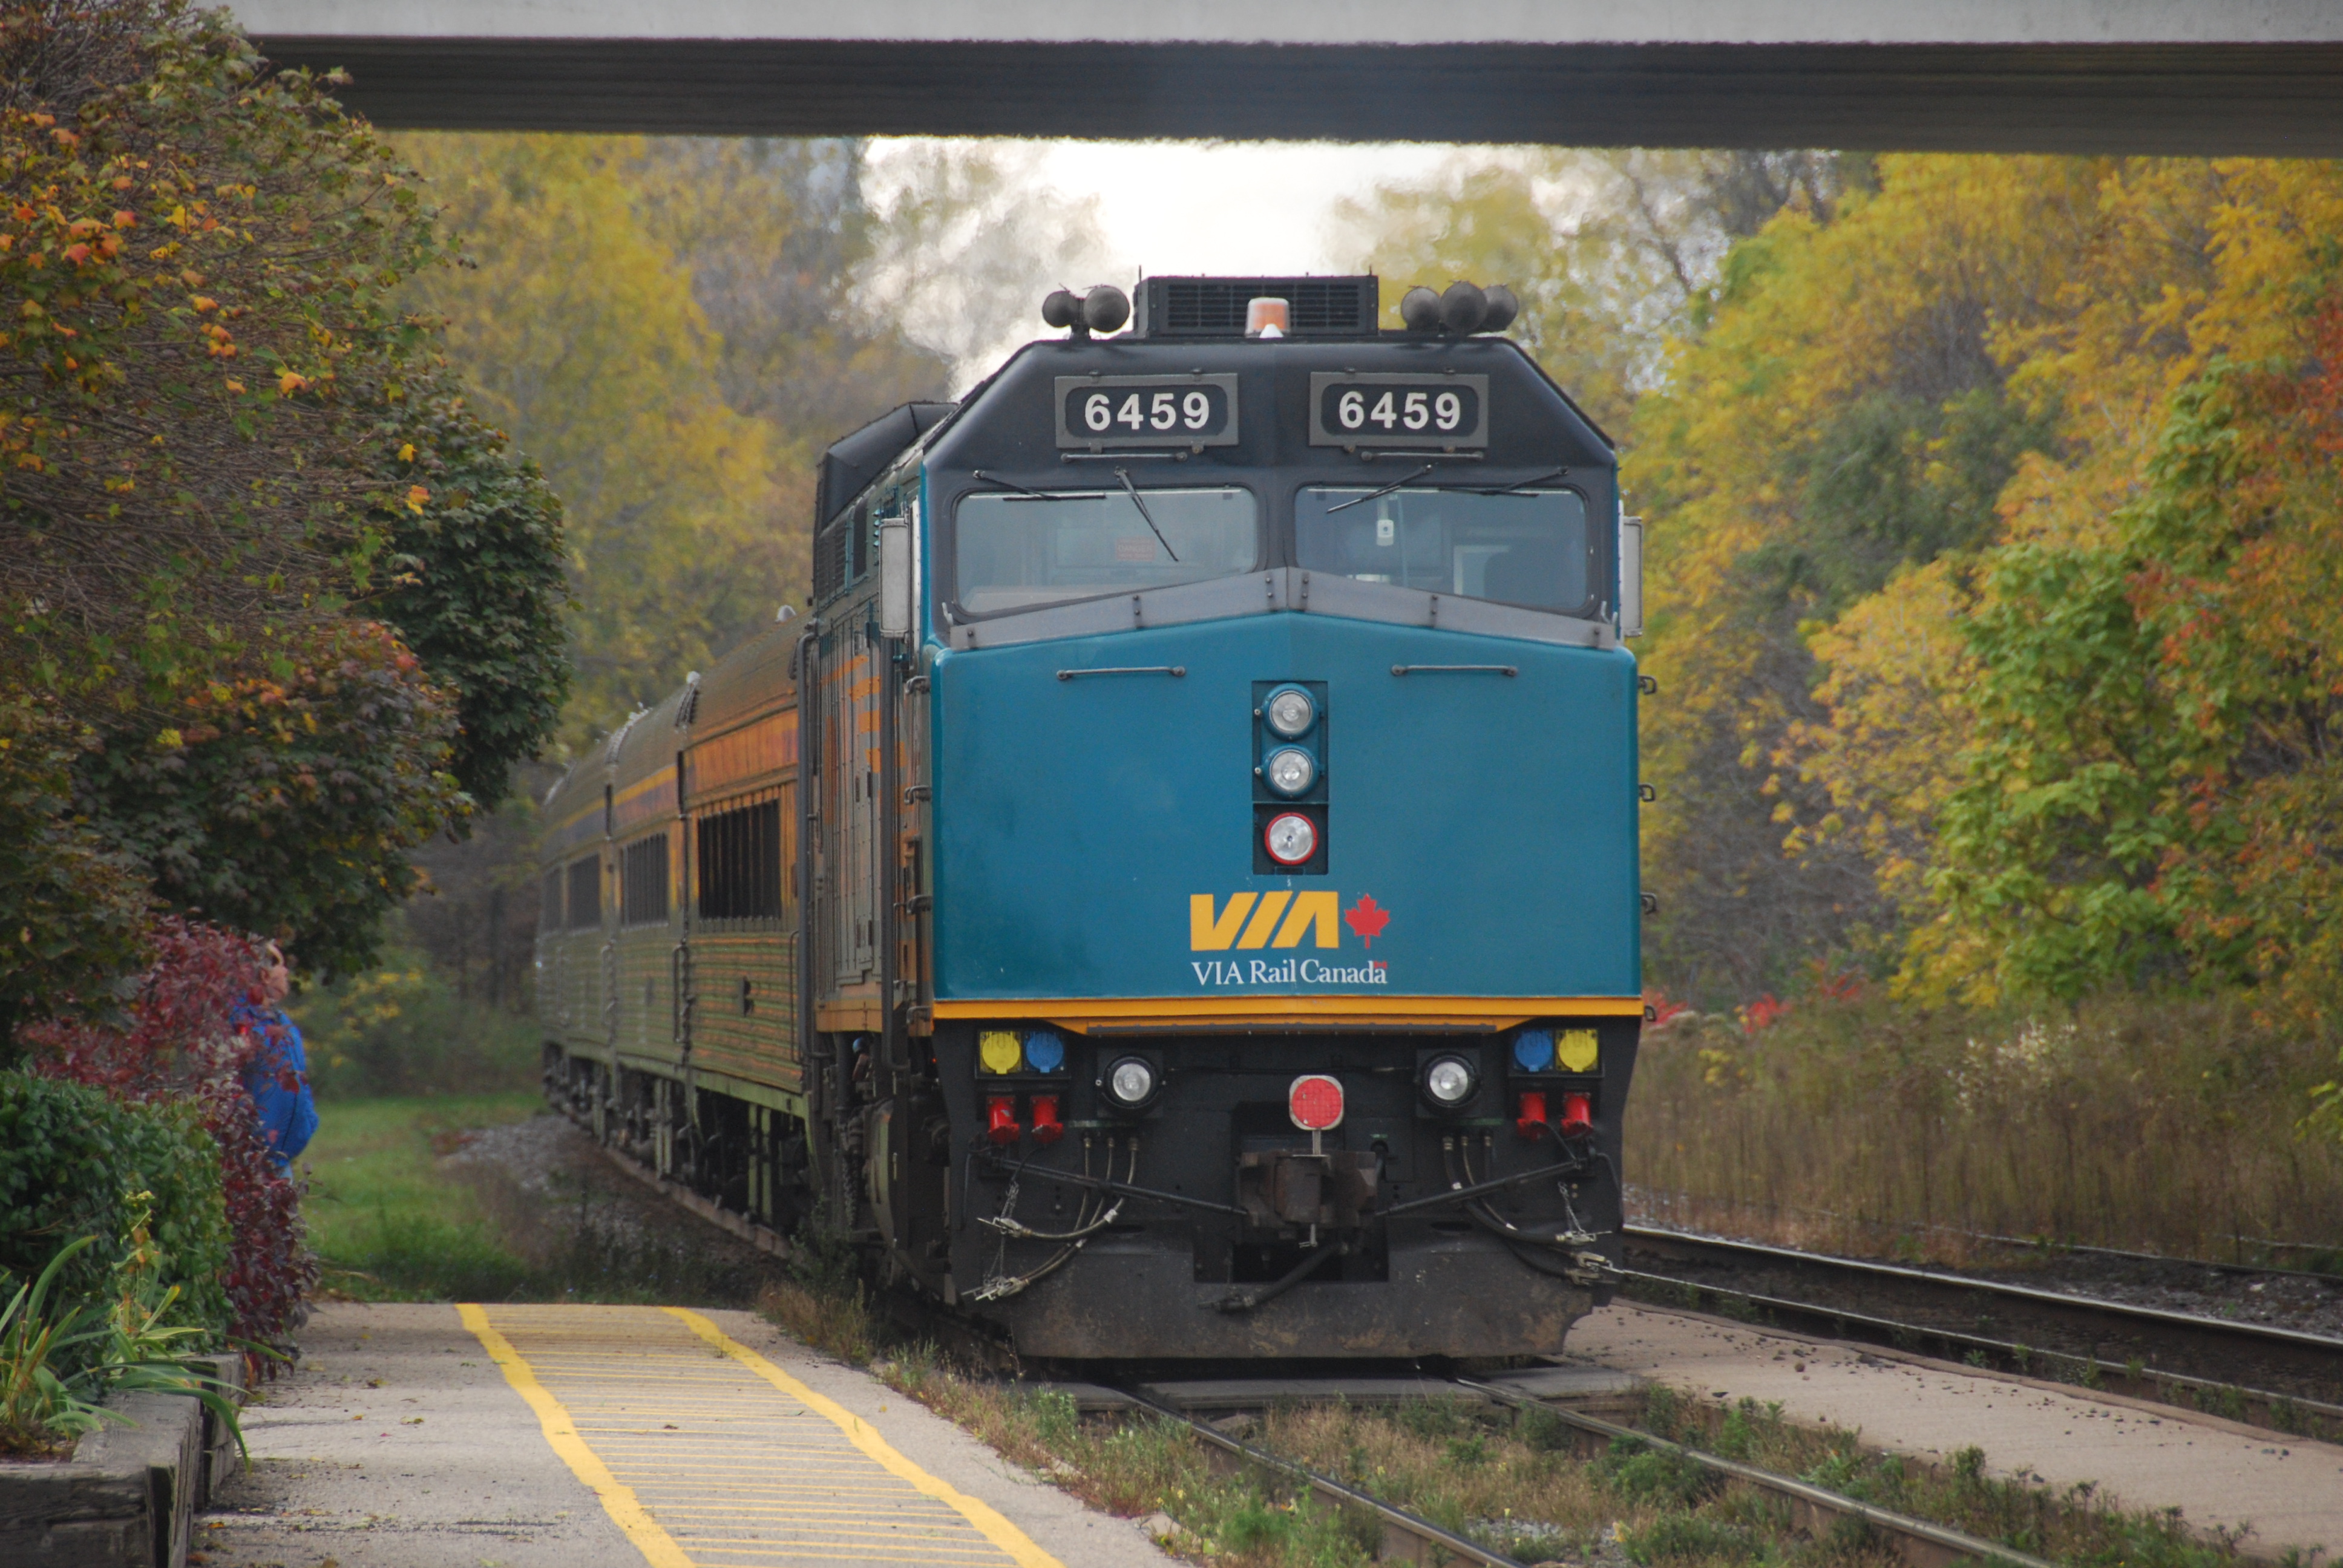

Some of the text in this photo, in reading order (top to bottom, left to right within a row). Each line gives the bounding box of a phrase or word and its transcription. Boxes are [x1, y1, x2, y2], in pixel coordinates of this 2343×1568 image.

[1084, 392, 1209, 430] 6459
[1339, 391, 1460, 430] 6459
[1190, 890, 1339, 951] VIA
[1191, 959, 1388, 985] VIA Rail Canada
